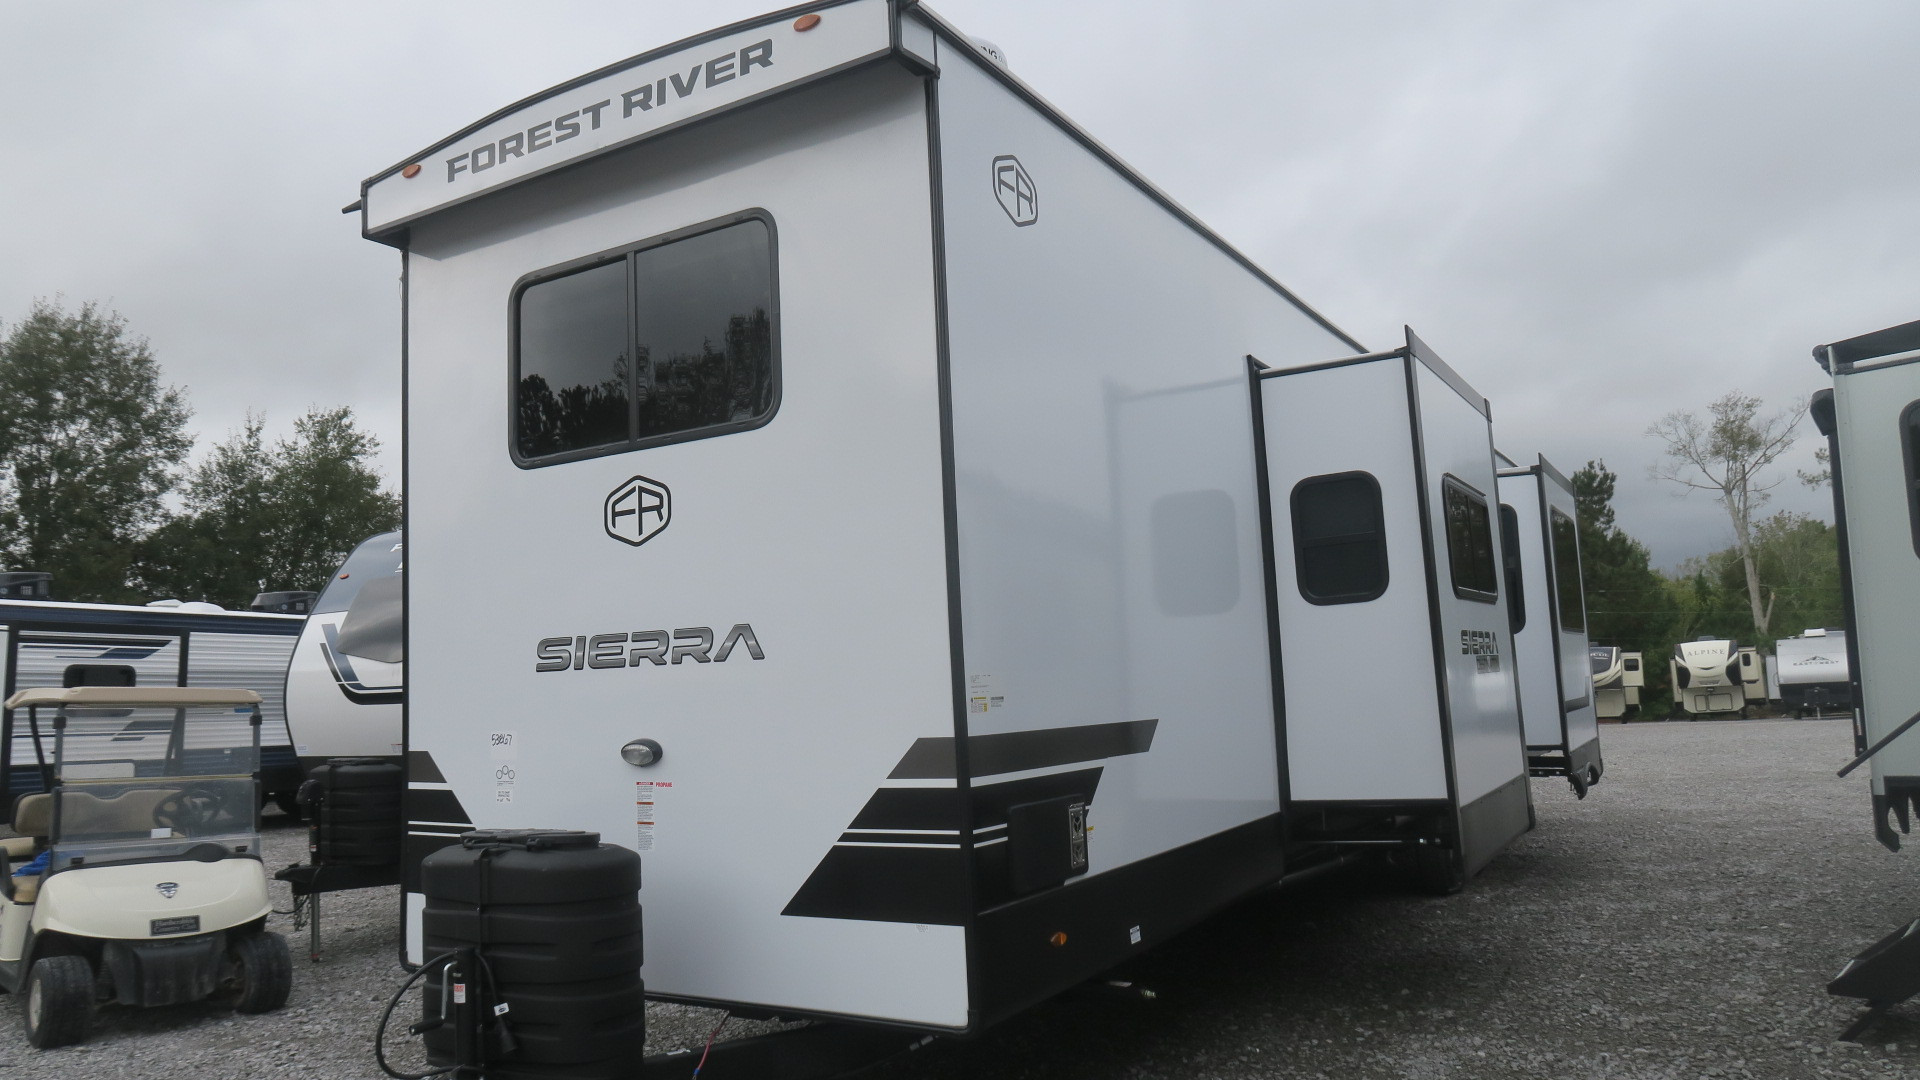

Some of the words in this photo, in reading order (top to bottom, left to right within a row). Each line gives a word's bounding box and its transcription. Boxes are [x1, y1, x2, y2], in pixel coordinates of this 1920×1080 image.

[446, 98, 611, 184] FOREST
[621, 38, 774, 119] RIVER
[535, 623, 766, 673] SIERRA
[1461, 629, 1499, 655] SIERRA
[1687, 648, 1725, 658] ALPINE
